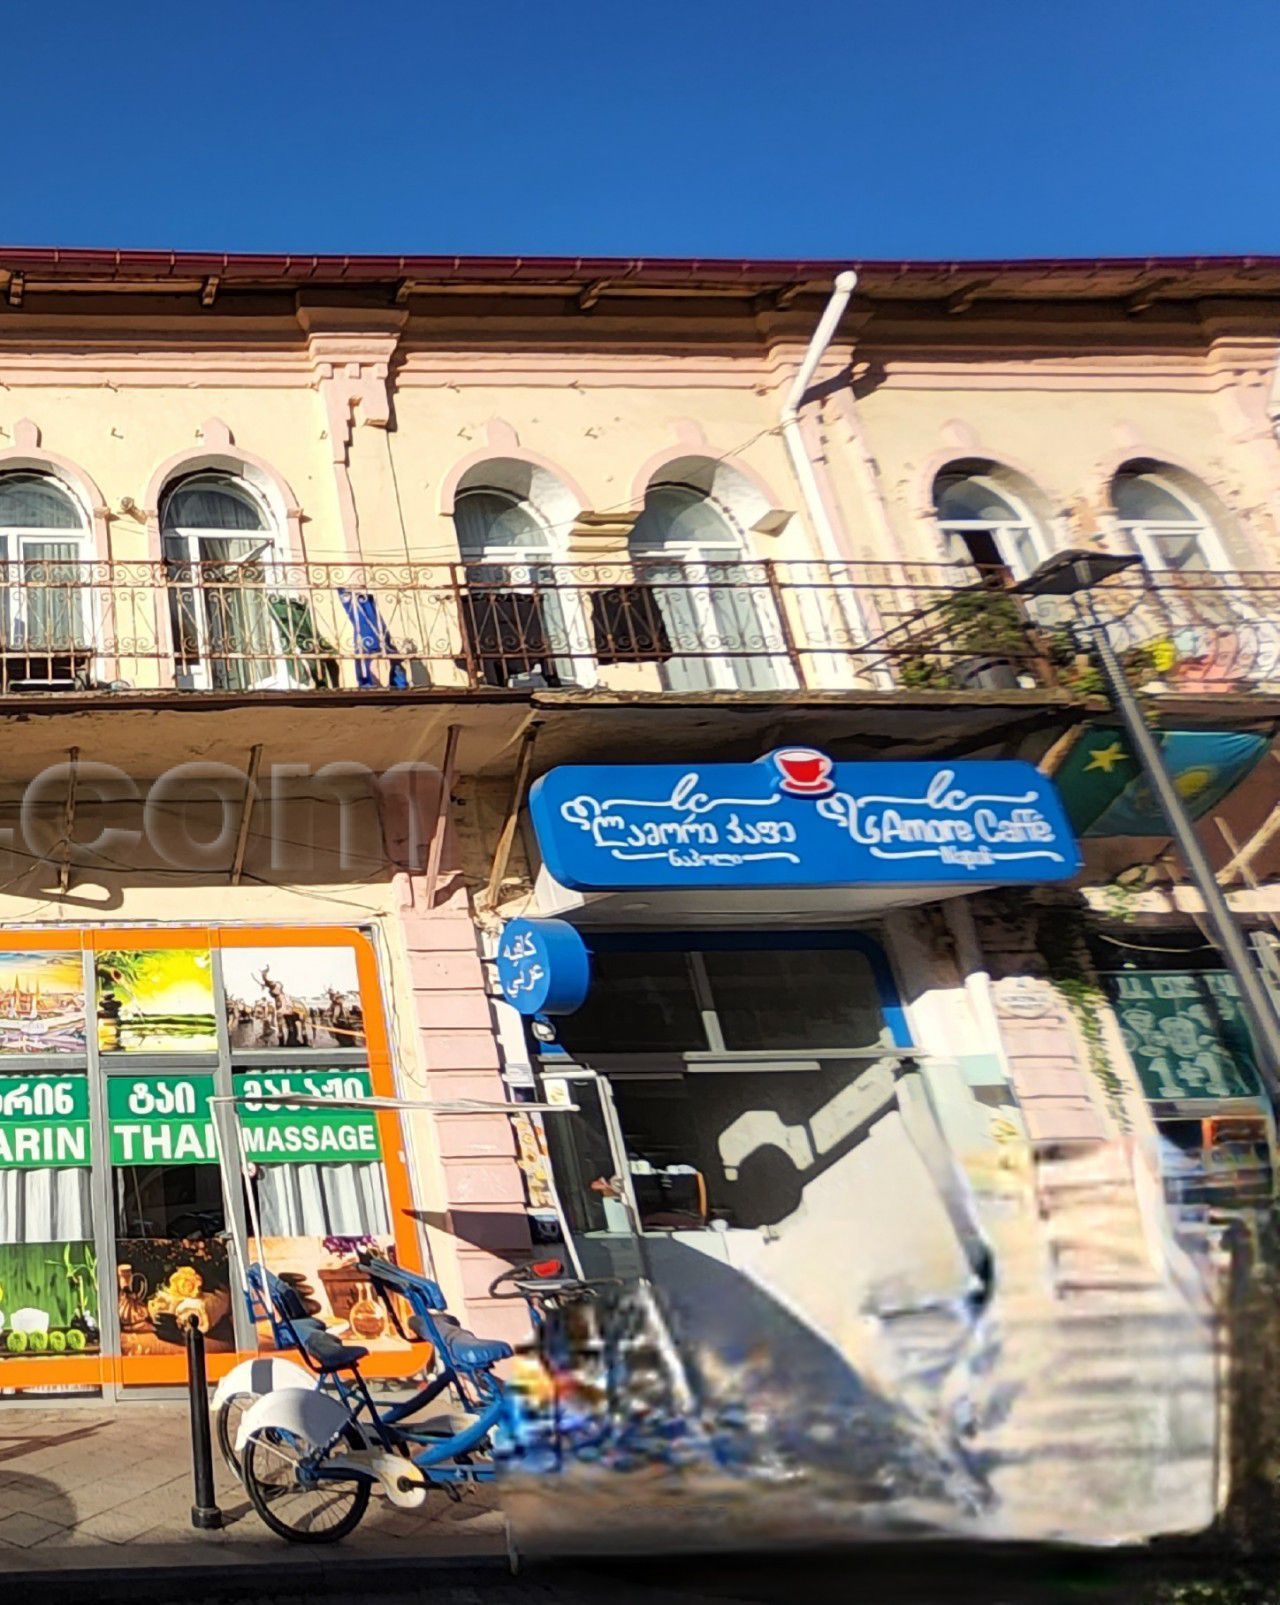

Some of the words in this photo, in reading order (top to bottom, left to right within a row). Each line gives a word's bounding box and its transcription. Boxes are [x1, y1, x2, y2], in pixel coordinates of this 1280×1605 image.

[726, 813, 797, 844] კაფე
[128, 1081, 196, 1115] ტაი
[113, 1124, 220, 1160] THAI
[243, 1124, 377, 1153] MASSAGE
